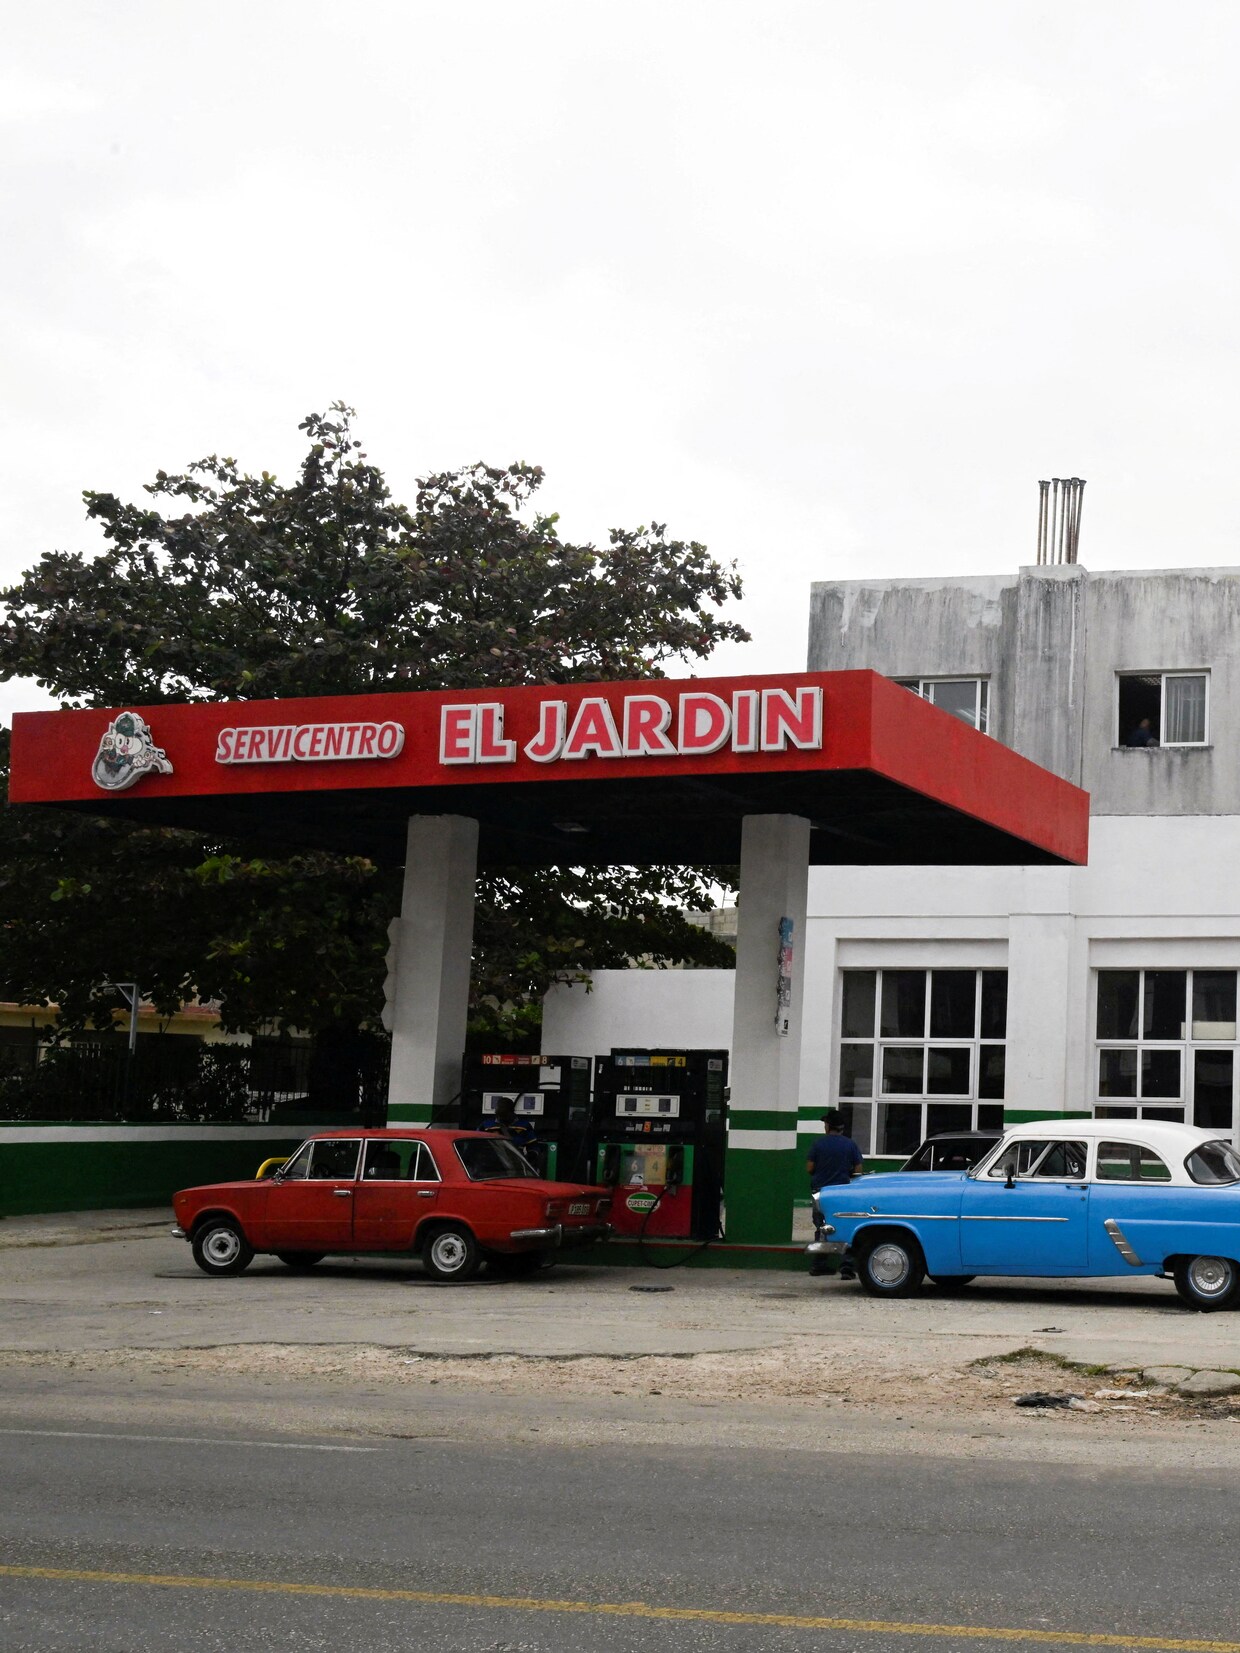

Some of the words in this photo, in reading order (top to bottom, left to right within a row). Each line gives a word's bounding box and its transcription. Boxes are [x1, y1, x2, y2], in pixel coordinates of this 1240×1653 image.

[217, 724, 400, 762] SERVICENTRO
[440, 703, 516, 765] EL
[524, 687, 823, 764] JARDIN
[483, 1055, 492, 1065] 10
